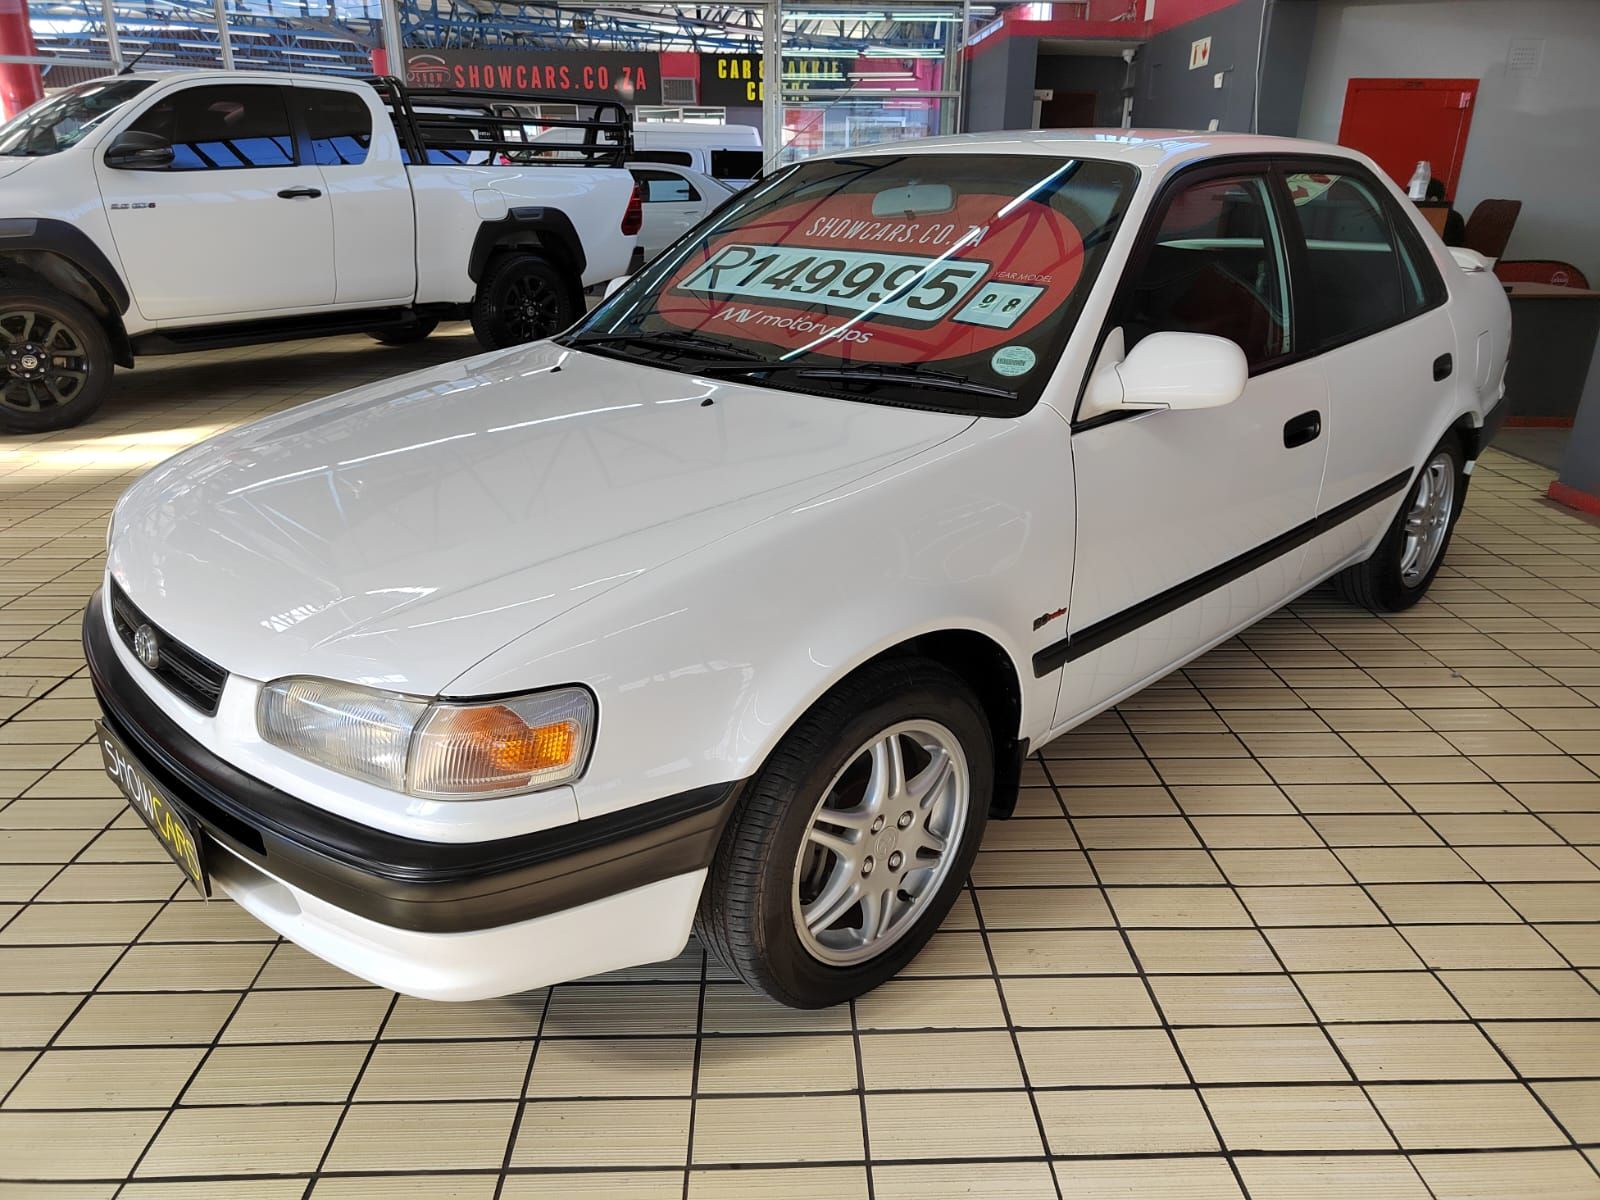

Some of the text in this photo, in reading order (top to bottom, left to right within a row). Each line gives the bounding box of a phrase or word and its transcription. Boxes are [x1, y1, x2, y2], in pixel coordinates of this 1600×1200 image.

[453, 64, 647, 91] SHOWCARS.CO.ZA
[718, 59, 752, 79] CAR
[780, 60, 839, 79] AKKIE
[805, 216, 990, 248] SHOWCARS.CO.ZA
[684, 246, 977, 310] R149995
